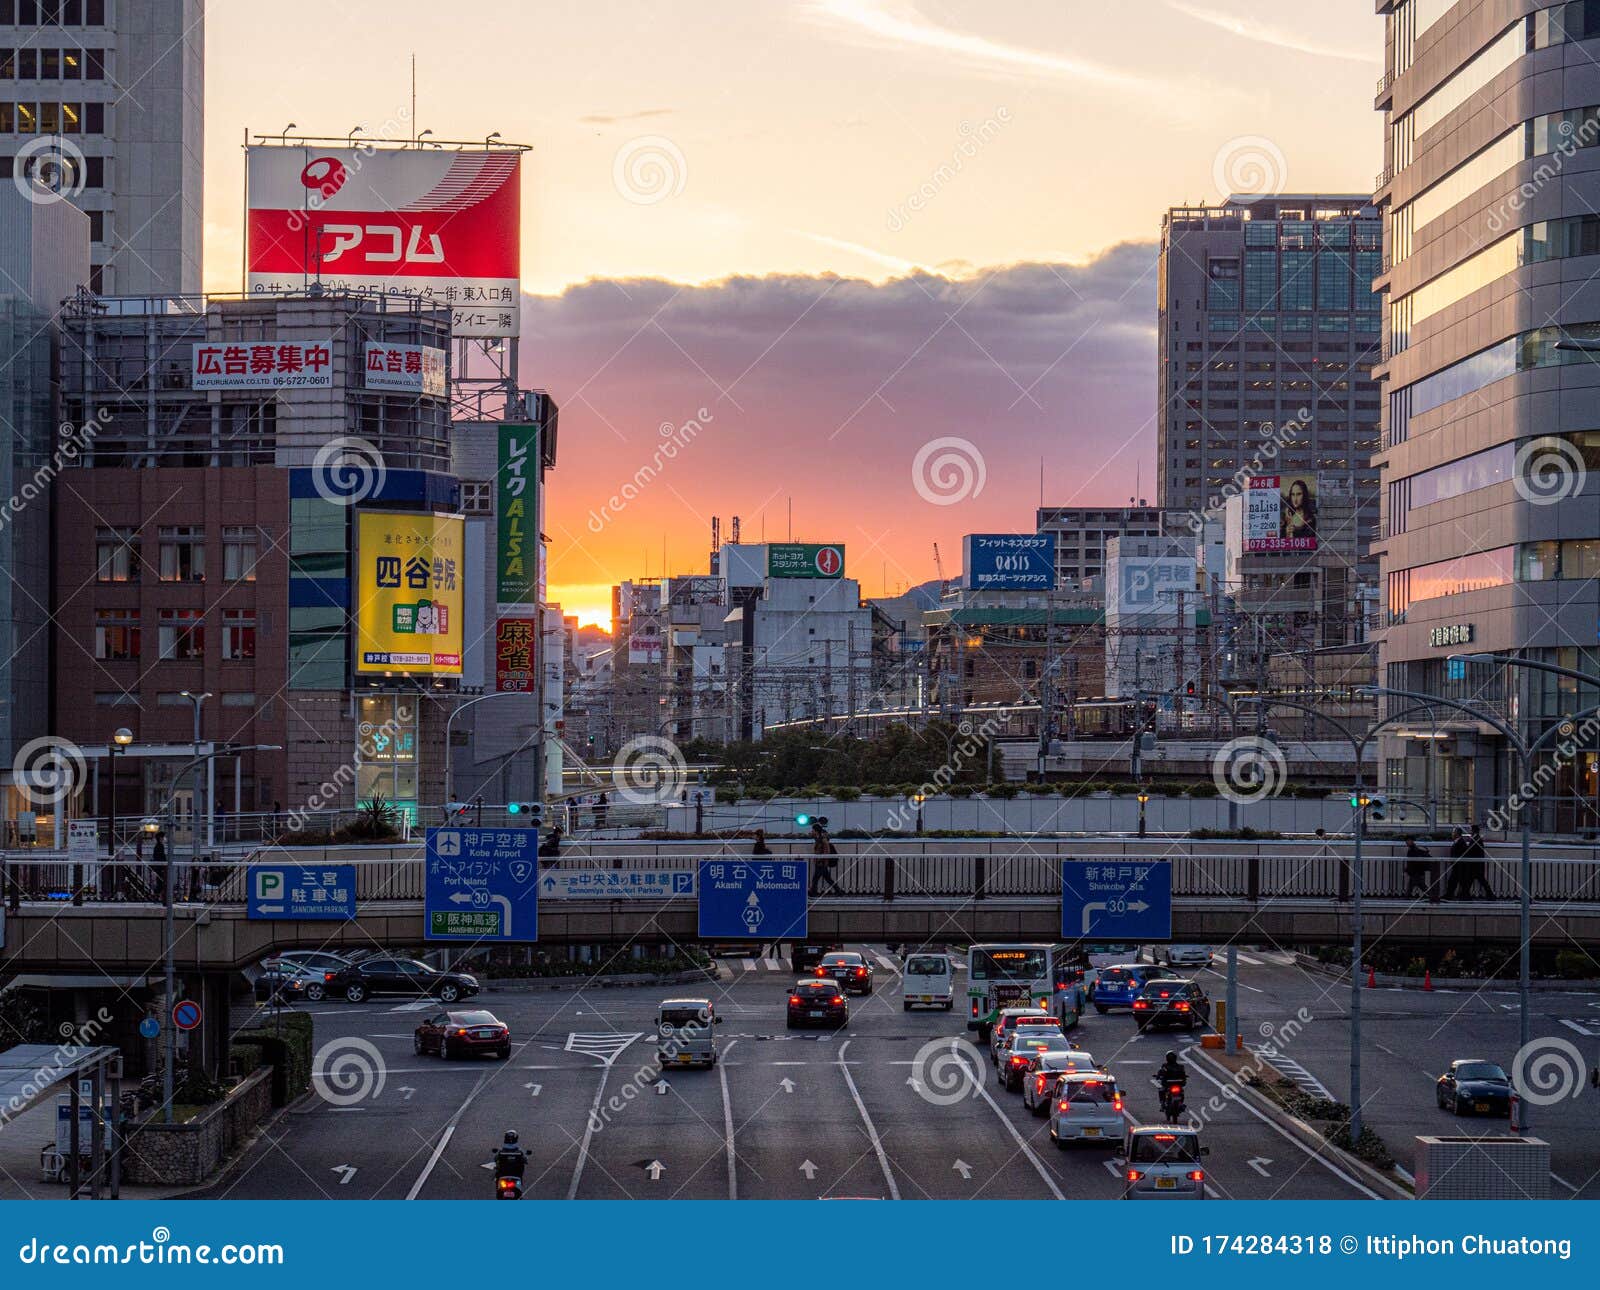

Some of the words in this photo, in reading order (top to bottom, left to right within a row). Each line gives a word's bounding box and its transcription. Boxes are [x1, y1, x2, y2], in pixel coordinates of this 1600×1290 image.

[322, 223, 445, 263] アコム
[196, 344, 329, 375] 広告募集中
[506, 437, 528, 497] レイク
[505, 498, 525, 577] ALSA
[1250, 540, 1311, 549] 078-335-1081
[772, 552, 804, 560] ホットヨガ
[376, 556, 456, 591] 四谷学院
[498, 621, 534, 670] 麻雀
[463, 833, 527, 848] 神戸空港
[469, 849, 491, 858] Kobe
[494, 849, 521, 858] Airport
[431, 861, 500, 874] ポートアイランド
[516, 864, 525, 877] 2
[709, 864, 747, 880] 明石
[759, 864, 797, 880] 元町
[1085, 867, 1149, 881] 新神戸駅
[261, 874, 280, 896] P
[302, 871, 337, 886] 三宮
[444, 877, 461, 886] Port
[463, 877, 487, 886] Island
[677, 875, 689, 891] P
[715, 881, 743, 889] Akashi
[756, 881, 800, 890] Motomachi
[1089, 882, 1126, 891] Shinkobe
[291, 888, 348, 902] 駐車場
[474, 892, 488, 904] 30
[1108, 900, 1126, 913] 30
[447, 913, 498, 926] 阪神高速
[746, 910, 761, 923] 21
